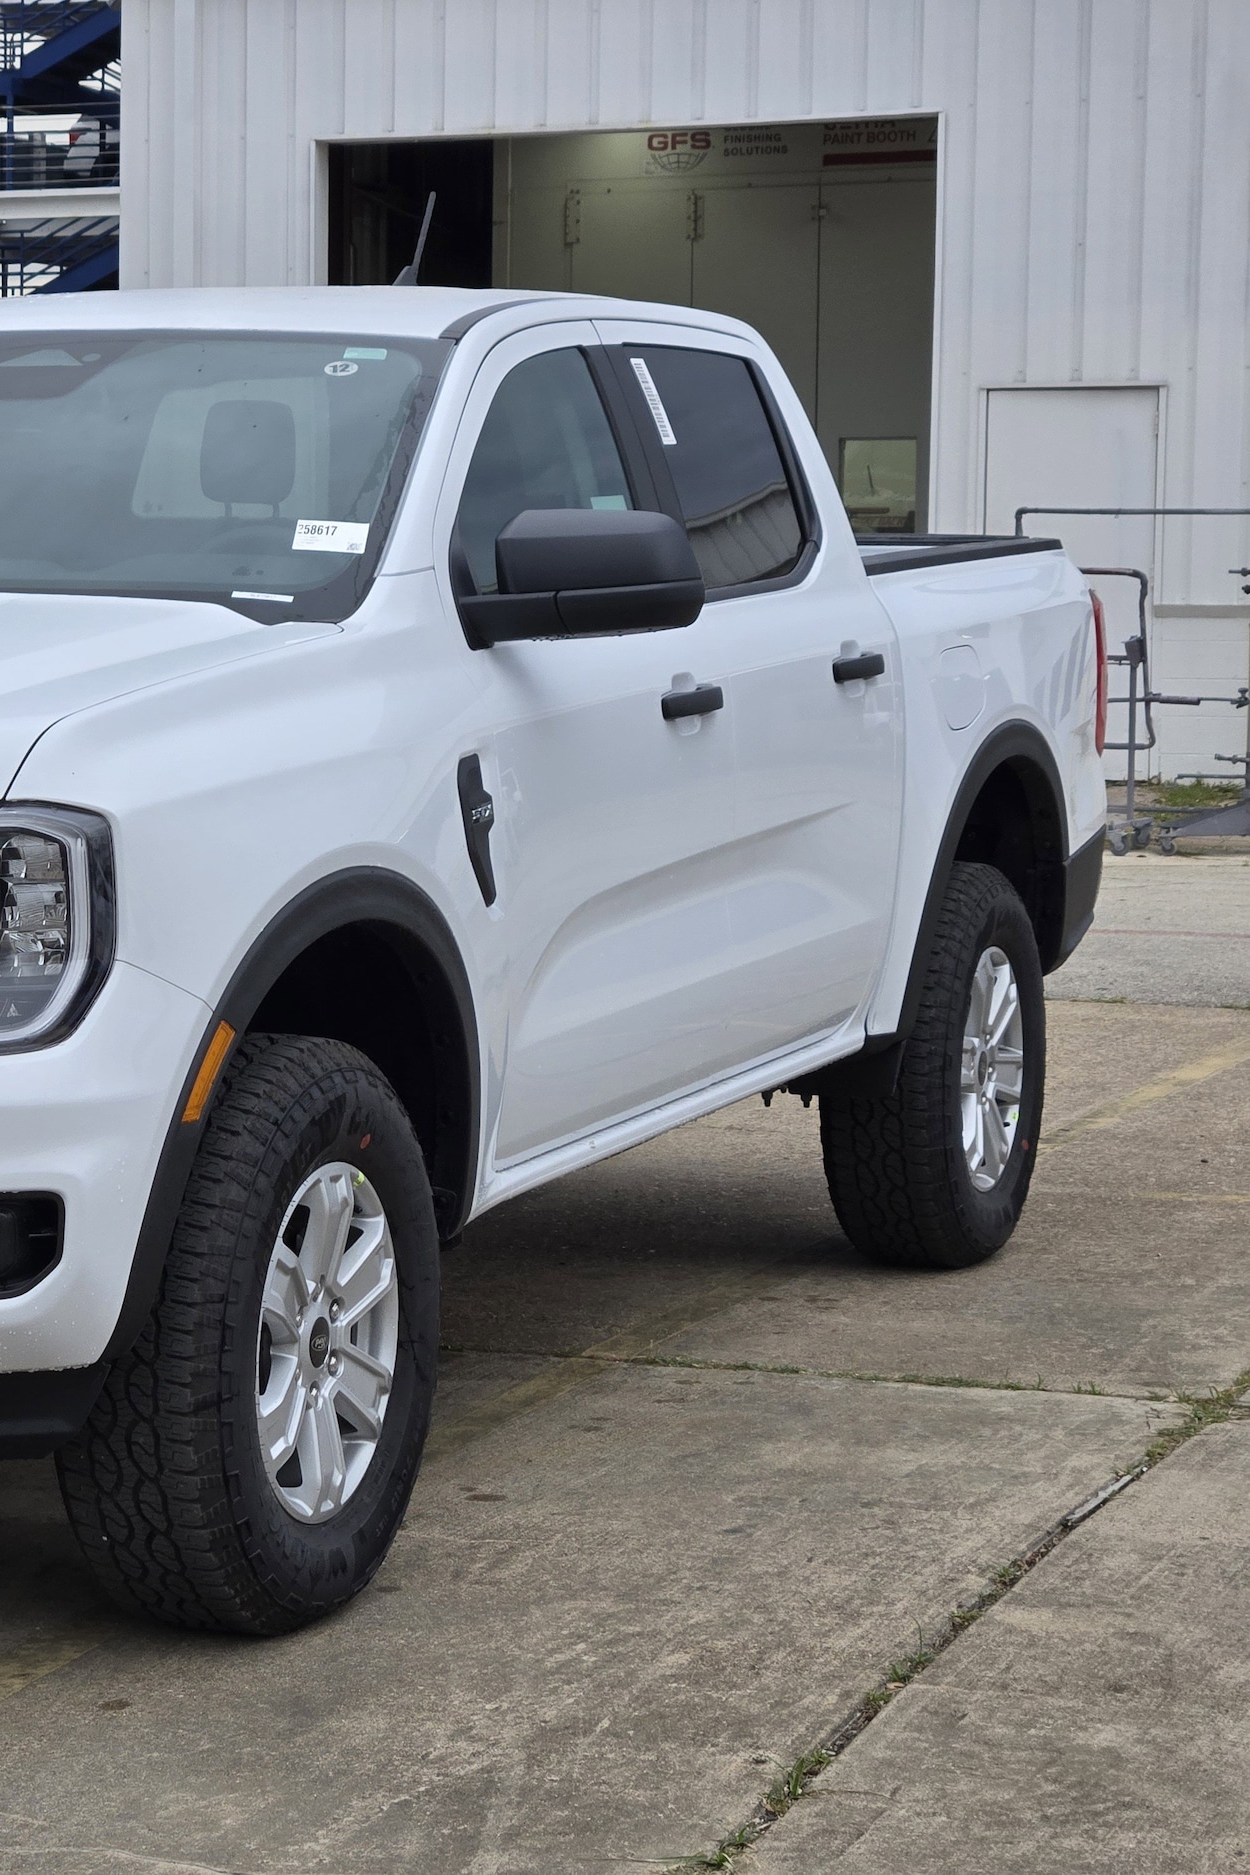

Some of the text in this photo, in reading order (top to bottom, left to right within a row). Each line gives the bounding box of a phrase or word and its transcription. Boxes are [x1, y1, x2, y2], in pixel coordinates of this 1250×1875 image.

[647, 130, 712, 151] GFS
[723, 133, 782, 144] FINISHING
[823, 129, 917, 145] PAINT BOOTH
[723, 145, 788, 157] SOLUTIONS
[329, 363, 351, 373] 12
